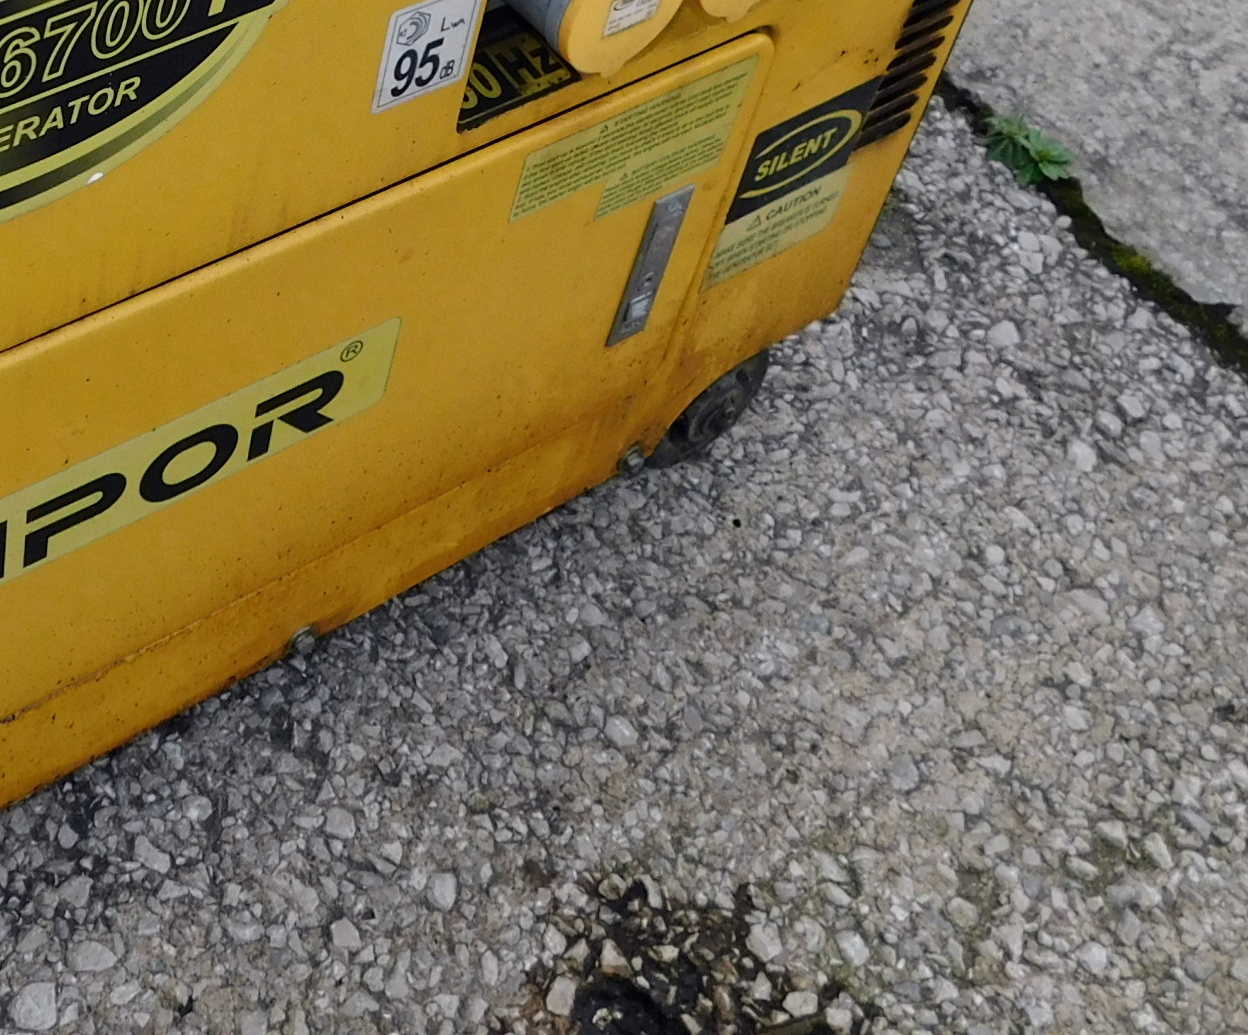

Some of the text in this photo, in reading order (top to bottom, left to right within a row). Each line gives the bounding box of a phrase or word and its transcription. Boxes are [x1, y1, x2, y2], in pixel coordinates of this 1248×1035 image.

[391, 37, 445, 97] 95
[754, 127, 838, 182] SILENT
[766, 185, 822, 221] CAUTION
